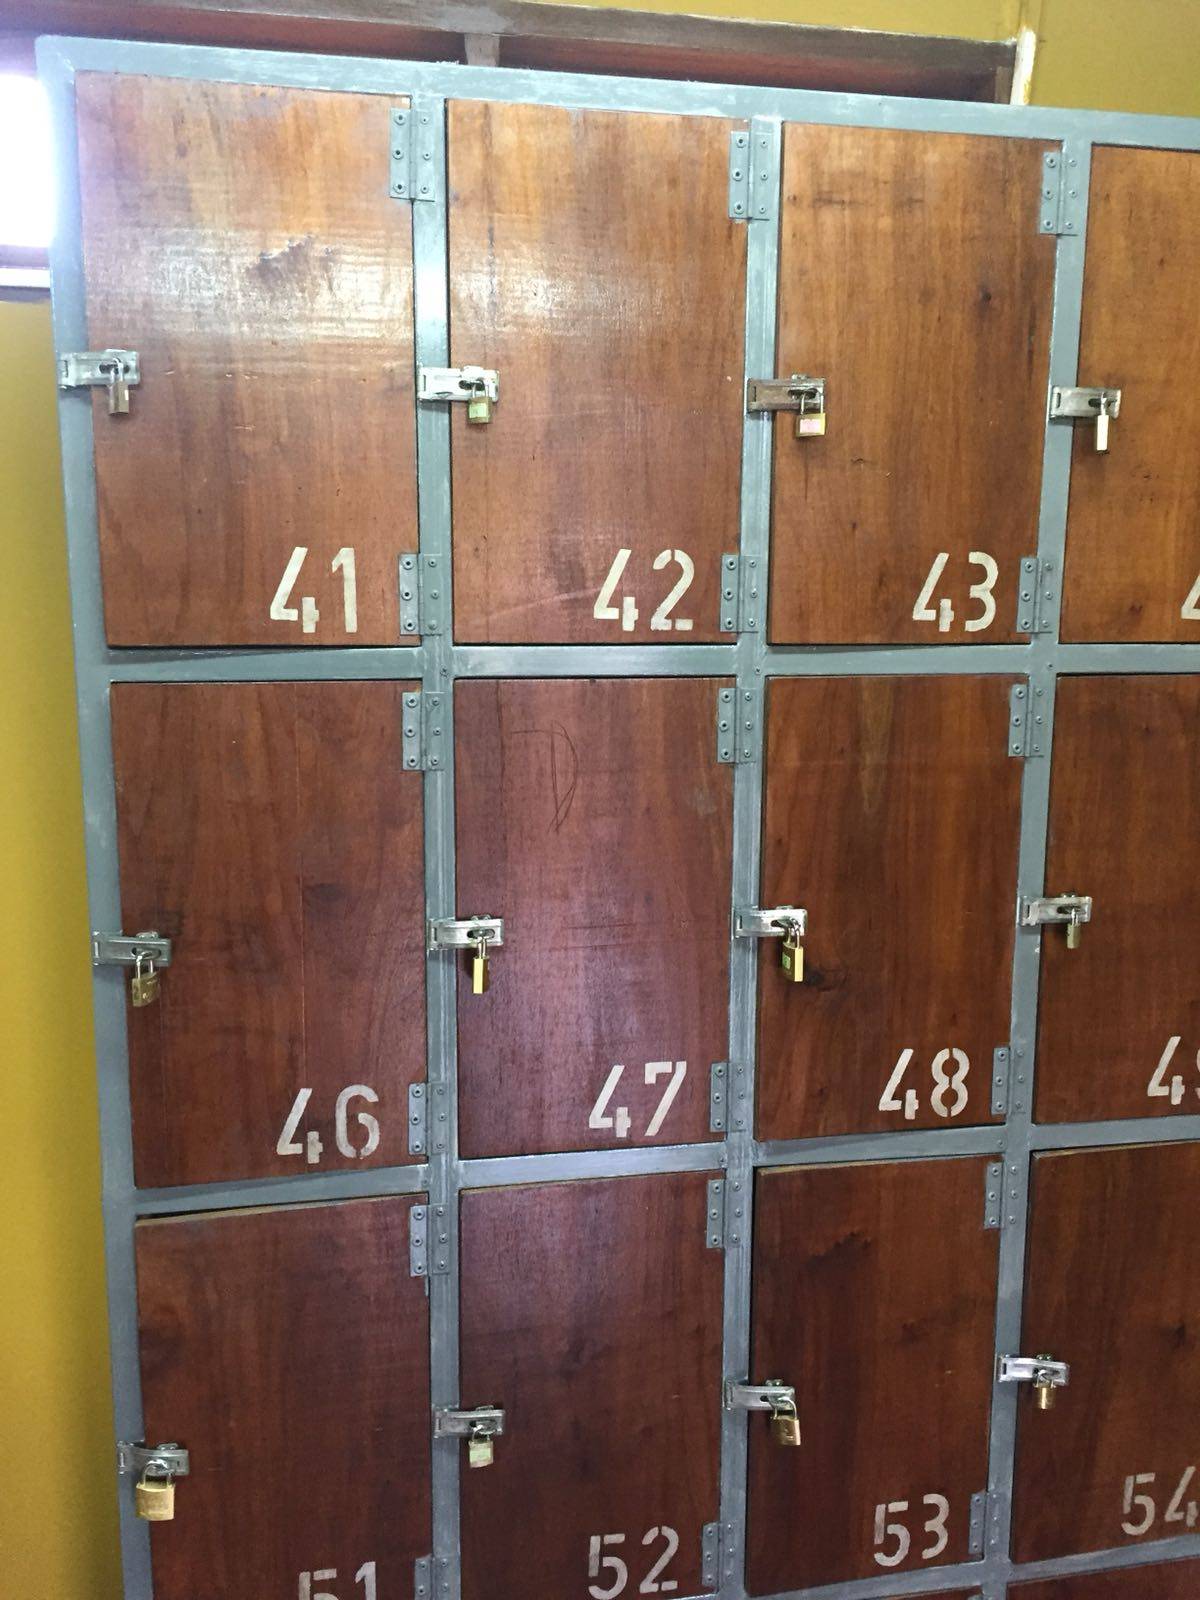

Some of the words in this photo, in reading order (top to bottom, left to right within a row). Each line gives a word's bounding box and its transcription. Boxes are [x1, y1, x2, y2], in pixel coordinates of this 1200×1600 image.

[270, 547, 357, 633] 41
[594, 549, 694, 631] 42
[913, 552, 998, 632] 43
[589, 1061, 686, 1137] 47
[879, 1048, 969, 1119] 48
[1148, 1036, 1200, 1106] 4
[277, 1085, 380, 1163] 46
[874, 1494, 948, 1567] 53
[1121, 1466, 1200, 1536] 54
[588, 1526, 678, 1600] 52
